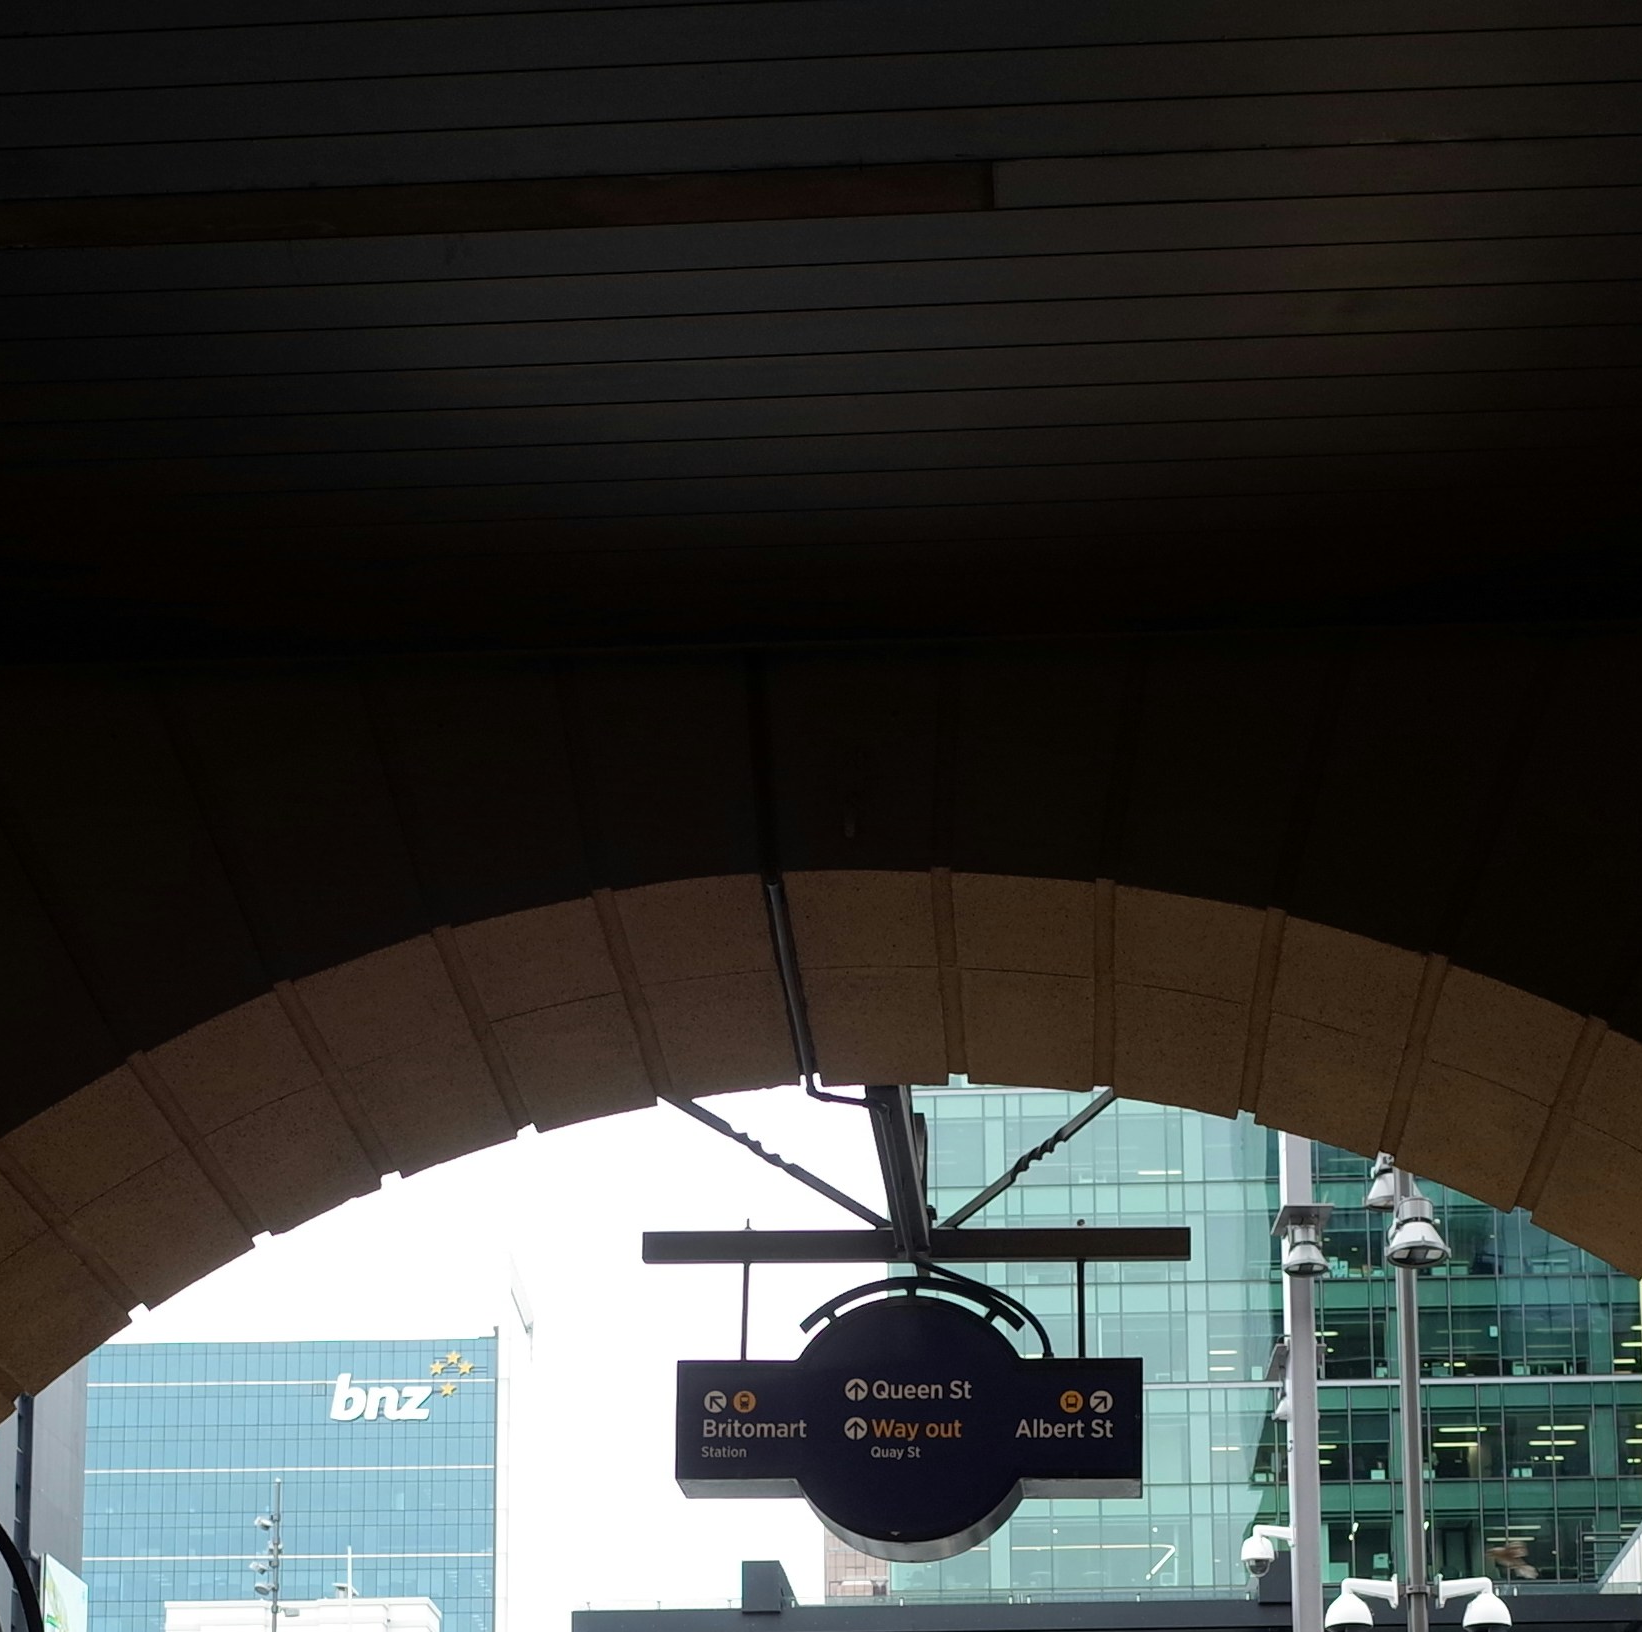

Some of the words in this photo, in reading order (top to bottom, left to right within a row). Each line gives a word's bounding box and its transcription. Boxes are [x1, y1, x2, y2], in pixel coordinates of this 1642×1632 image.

[330, 1373, 432, 1421] bnz
[872, 1380, 943, 1402] Queen
[949, 1380, 973, 1399] St
[701, 1419, 807, 1439] Britomart
[871, 1419, 919, 1441] Way
[925, 1420, 962, 1439] out
[1015, 1419, 1084, 1438] Albert
[1090, 1419, 1114, 1439] St
[701, 1446, 747, 1458] Station
[870, 1446, 904, 1461] Quay
[907, 1446, 921, 1458] St
